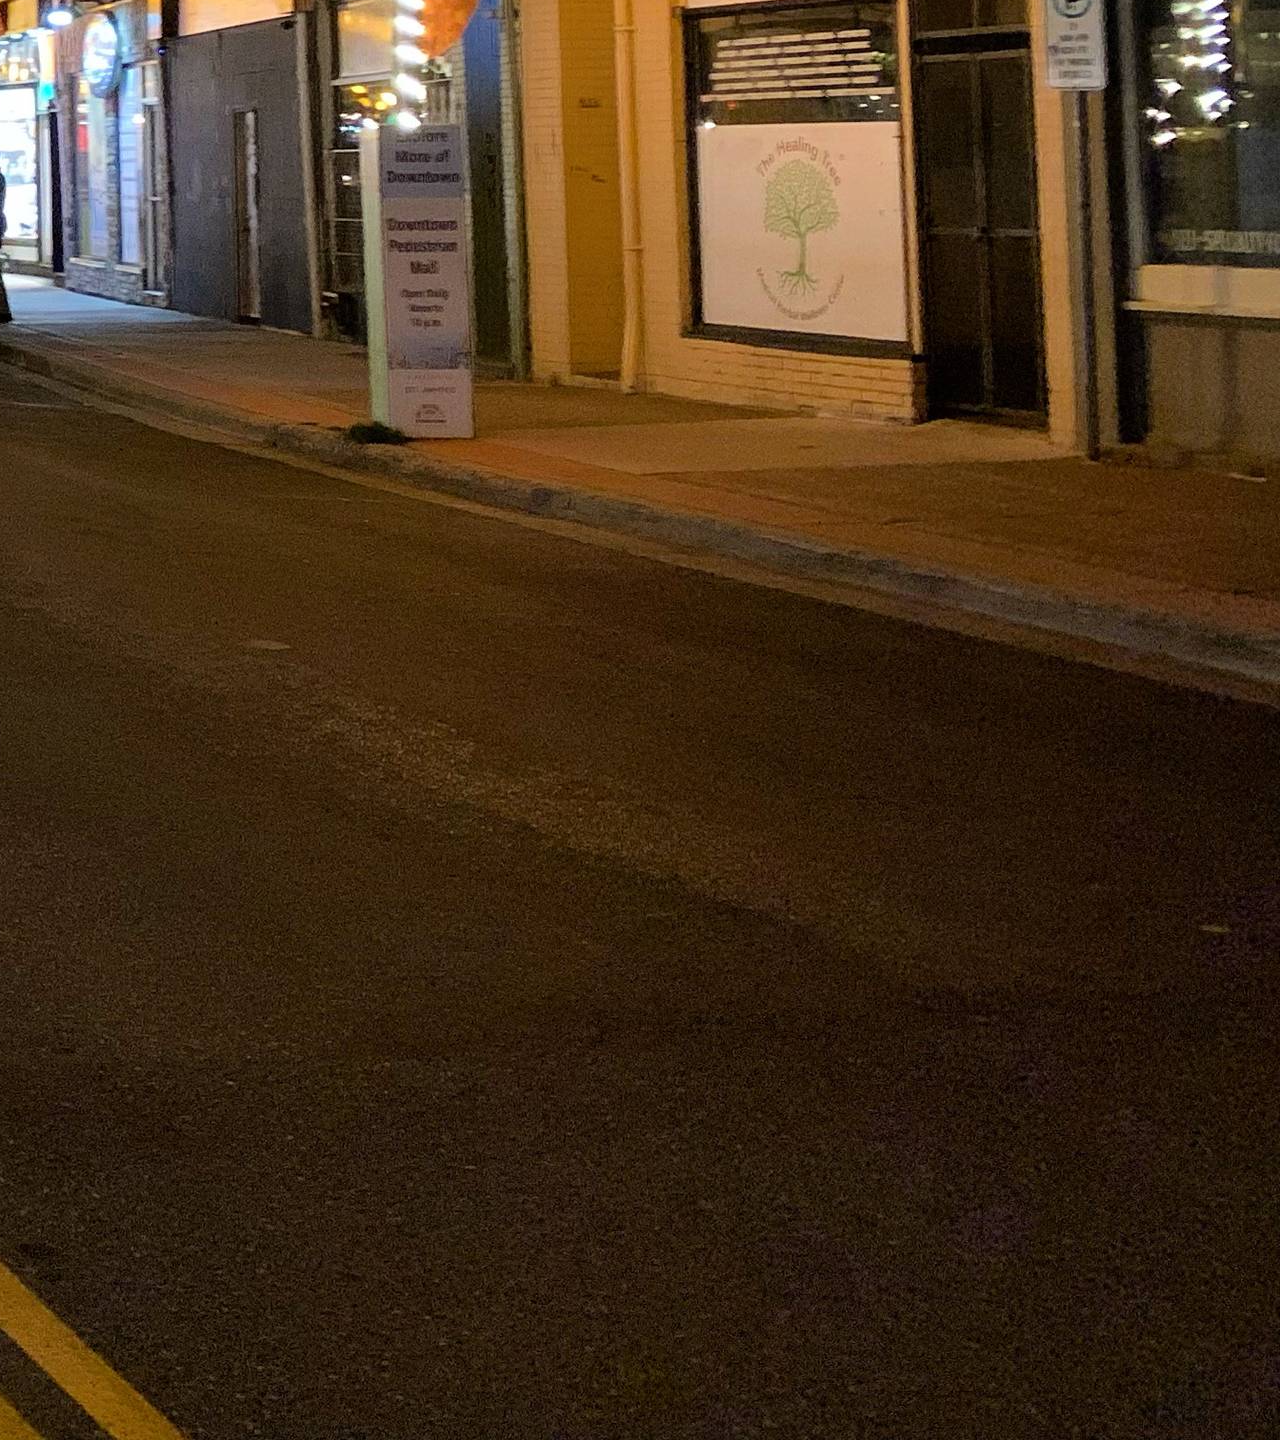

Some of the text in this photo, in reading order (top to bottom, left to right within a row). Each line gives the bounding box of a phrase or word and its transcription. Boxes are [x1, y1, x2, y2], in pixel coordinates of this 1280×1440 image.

[395, 150, 433, 163] More
[757, 136, 841, 187] The Healing Tree
[387, 171, 460, 183] Downtown
